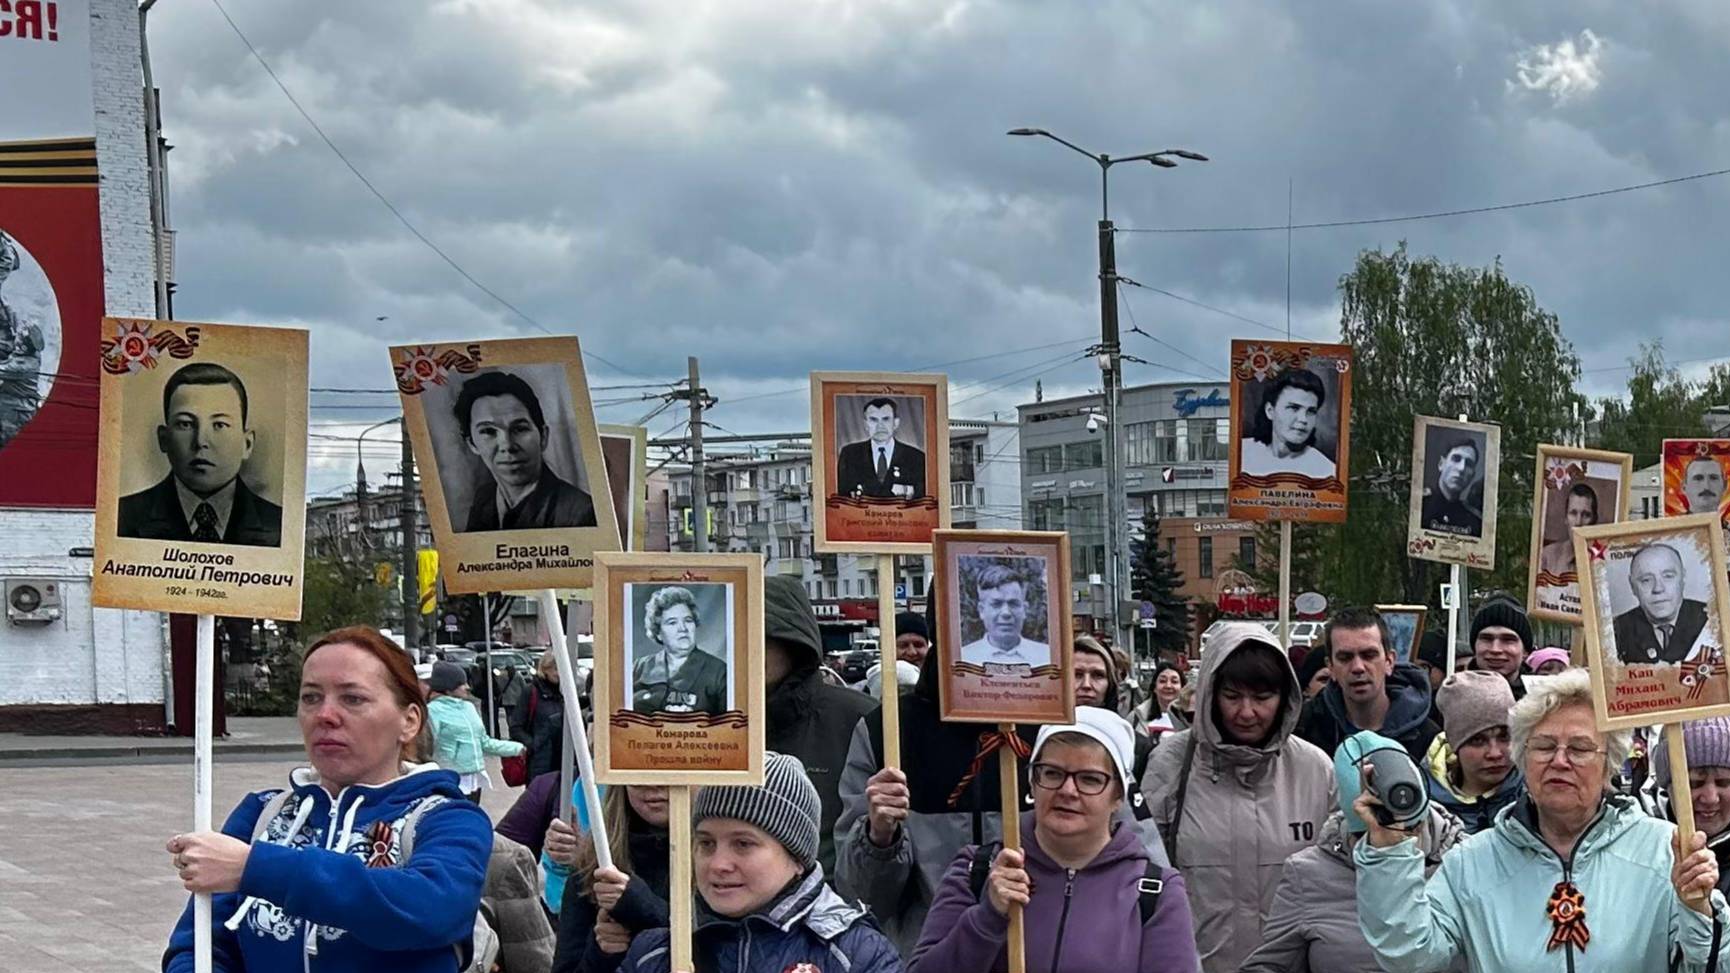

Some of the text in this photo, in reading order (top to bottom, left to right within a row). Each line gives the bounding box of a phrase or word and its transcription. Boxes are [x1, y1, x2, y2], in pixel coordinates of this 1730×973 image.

[1261, 490, 1316, 499] ПАВЕЛИНА
[163, 548, 234, 565] Шолохов
[496, 544, 569, 559] Елагина
[102, 559, 294, 587] Анатолий Петрович
[457, 558, 532, 573] Александра
[166, 586, 186, 595] 1924
[1628, 668, 1654, 679] Кап
[1615, 683, 1665, 697] Михаил
[1608, 695, 1682, 713] Абрамович
[656, 729, 708, 740] Комарова
[1288, 821, 1313, 841] TO
